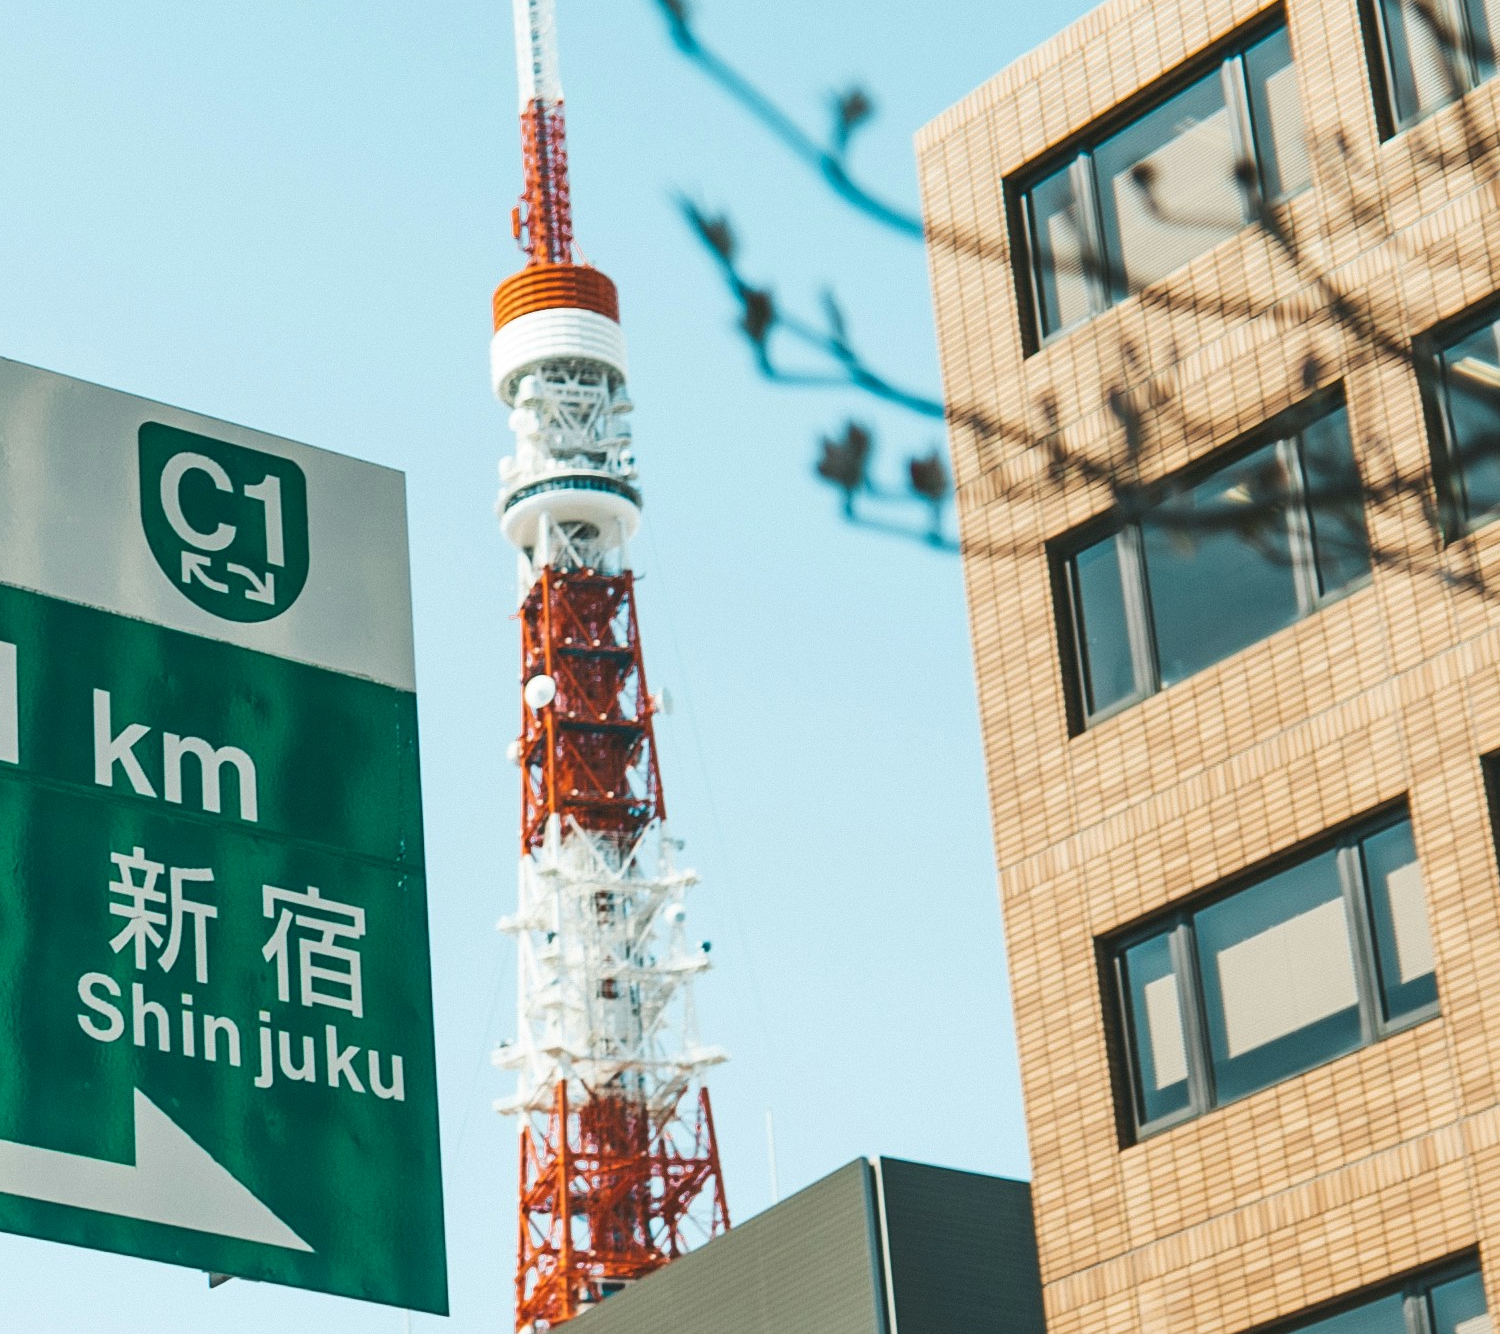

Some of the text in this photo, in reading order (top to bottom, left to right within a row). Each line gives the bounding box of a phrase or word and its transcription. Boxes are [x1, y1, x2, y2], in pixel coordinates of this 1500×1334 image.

[160, 451, 286, 569] C1
[92, 687, 259, 823] km
[109, 846, 366, 1020] 新宿
[76, 971, 406, 1103] Shinjuku
